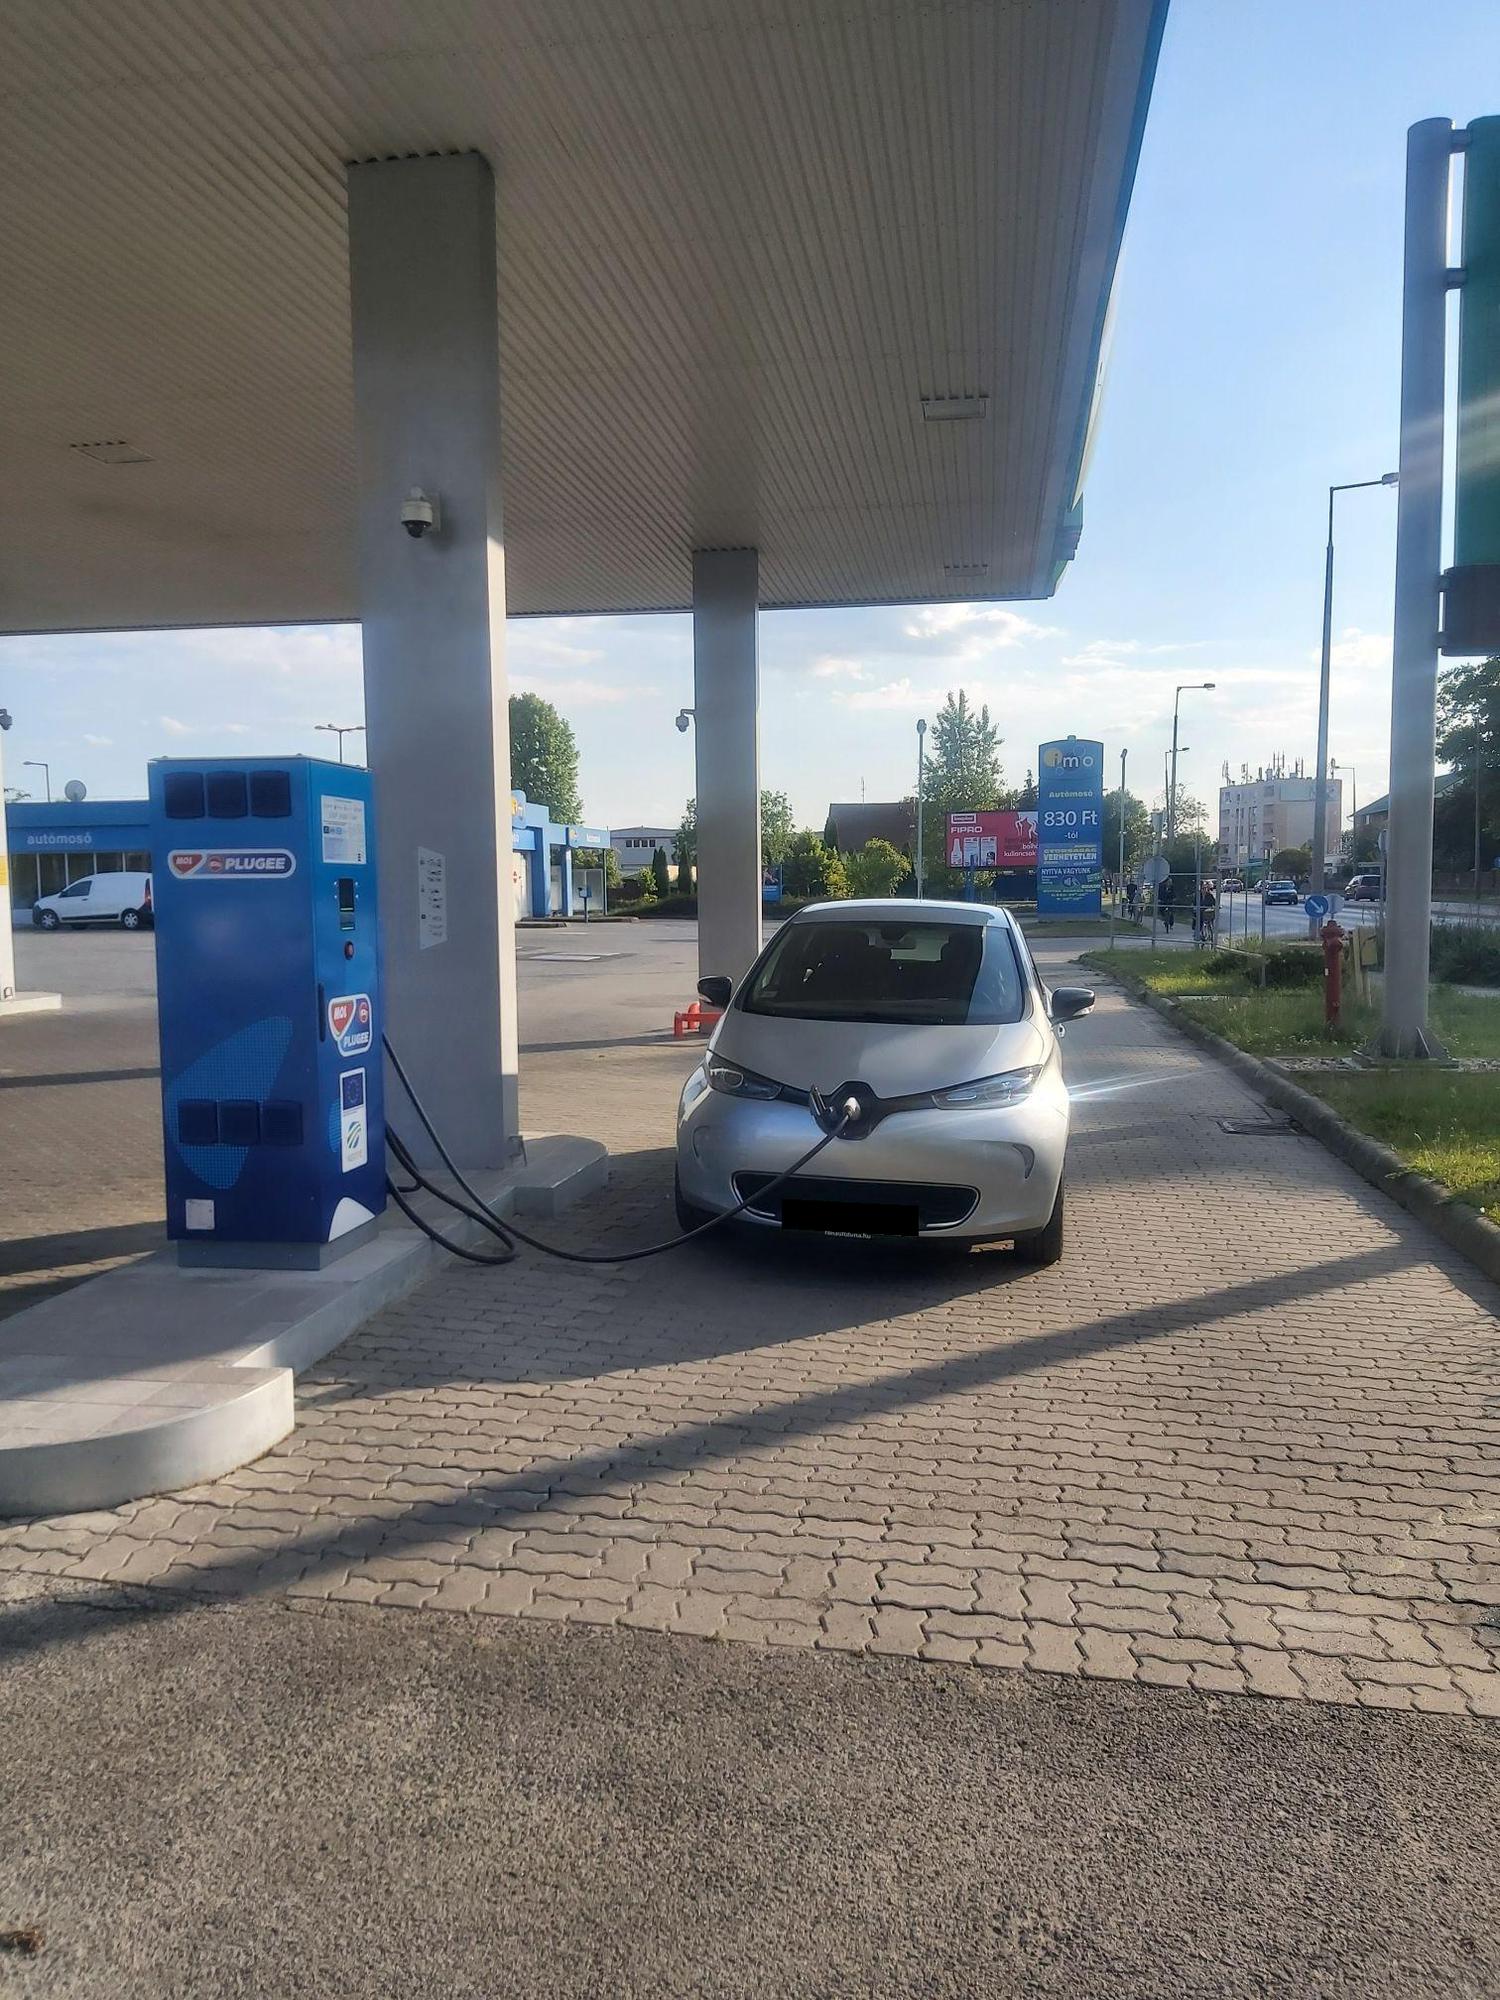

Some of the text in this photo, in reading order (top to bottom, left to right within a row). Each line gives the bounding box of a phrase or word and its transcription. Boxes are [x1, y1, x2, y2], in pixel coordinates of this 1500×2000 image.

[1050, 752, 1094, 768] imo
[1044, 810, 1098, 826] 830 Ft
[225, 858, 286, 870] PLUGEE
[343, 1031, 369, 1048] PLUGEE
